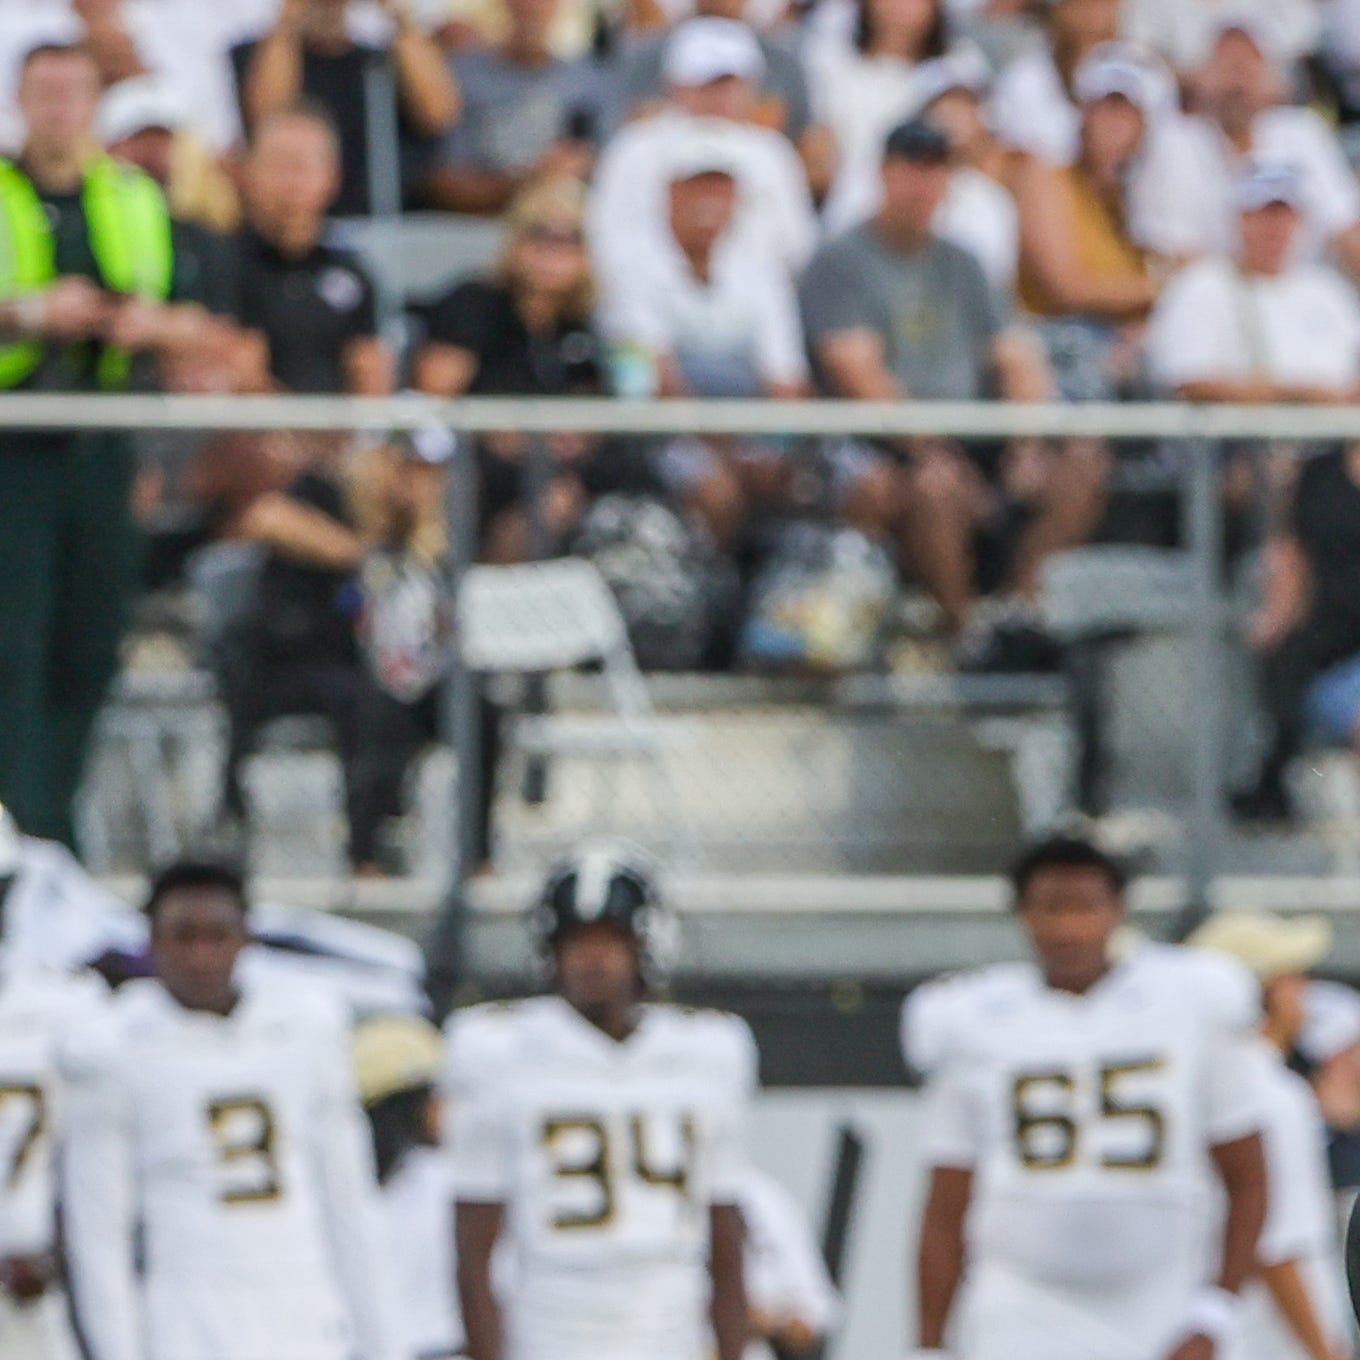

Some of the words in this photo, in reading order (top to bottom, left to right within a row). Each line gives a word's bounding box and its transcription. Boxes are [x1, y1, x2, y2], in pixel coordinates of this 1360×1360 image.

[204, 1094, 282, 1205] 3
[541, 1112, 697, 1229] 34
[1010, 1056, 1168, 1172] 65
